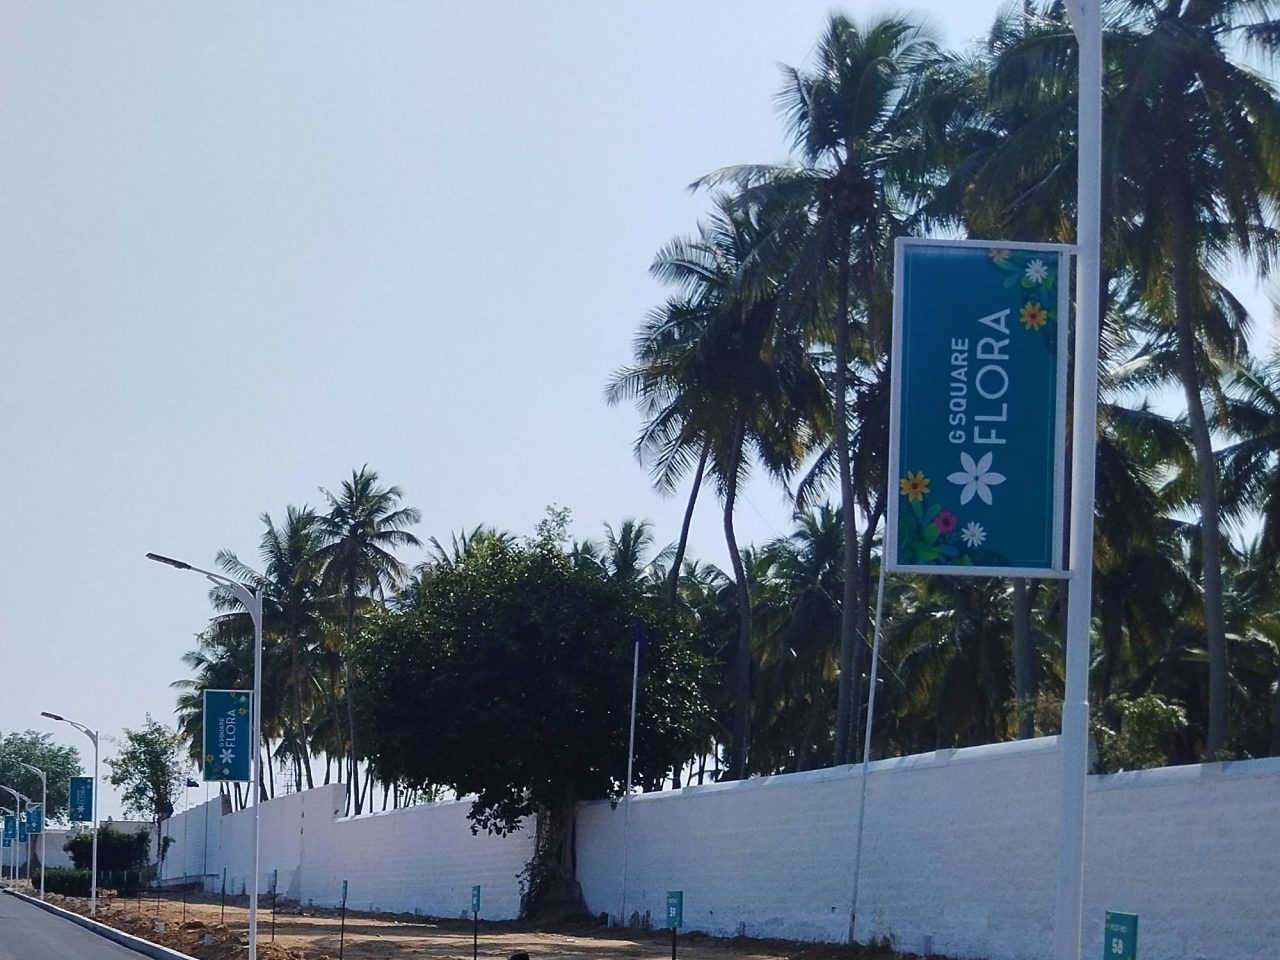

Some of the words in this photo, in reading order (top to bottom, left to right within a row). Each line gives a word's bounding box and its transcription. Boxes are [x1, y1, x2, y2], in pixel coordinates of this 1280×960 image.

[951, 337, 969, 426] SQUARE
[974, 308, 1010, 444] FLORA
[949, 430, 965, 444] G
[226, 709, 236, 747] FLORA
[1112, 938, 1123, 954] 58
